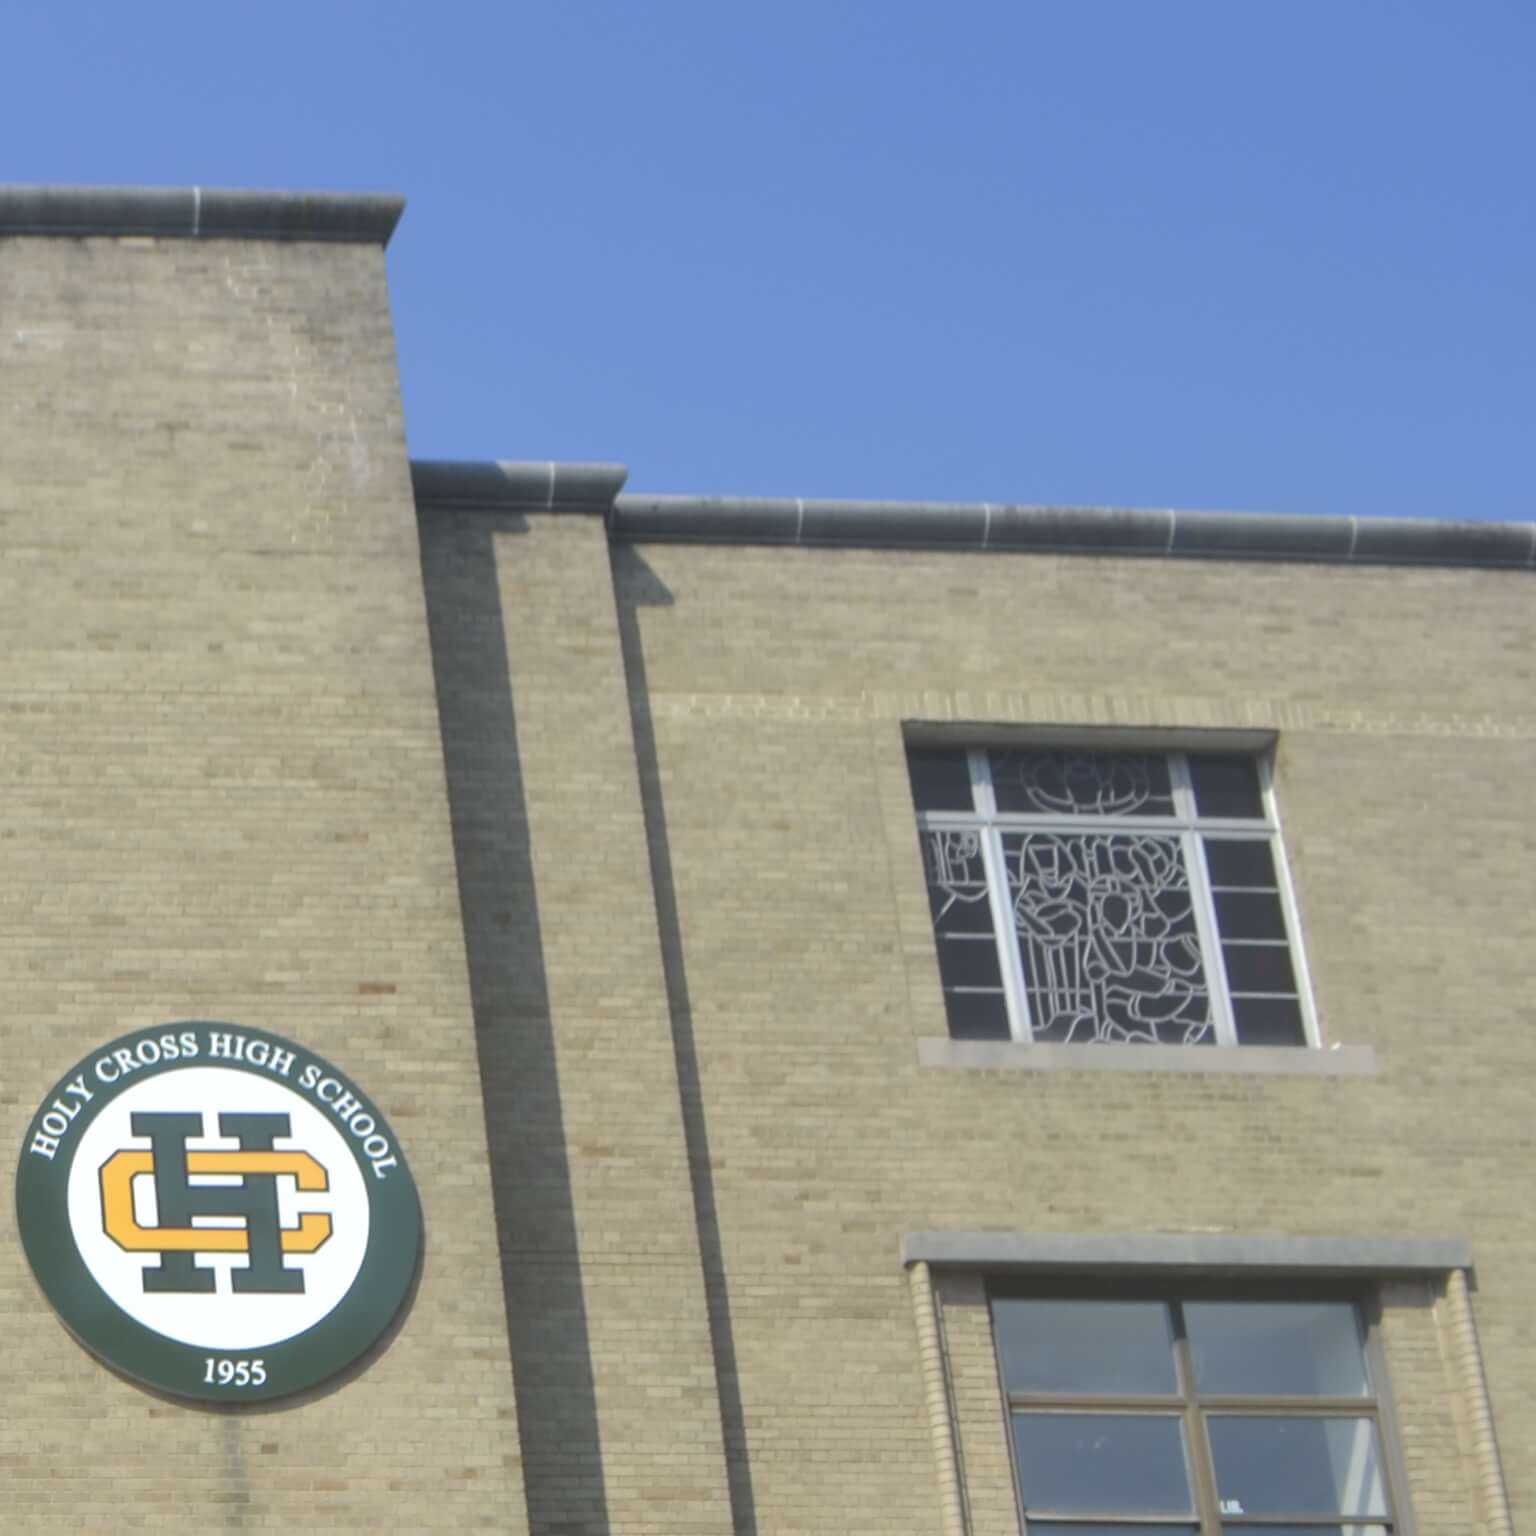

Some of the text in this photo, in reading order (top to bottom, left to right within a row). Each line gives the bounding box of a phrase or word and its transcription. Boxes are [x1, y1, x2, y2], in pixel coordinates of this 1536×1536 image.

[30, 1032, 398, 1178] HOLY CROSS HIGH SCHOOL
[203, 1358, 267, 1386] 1955
